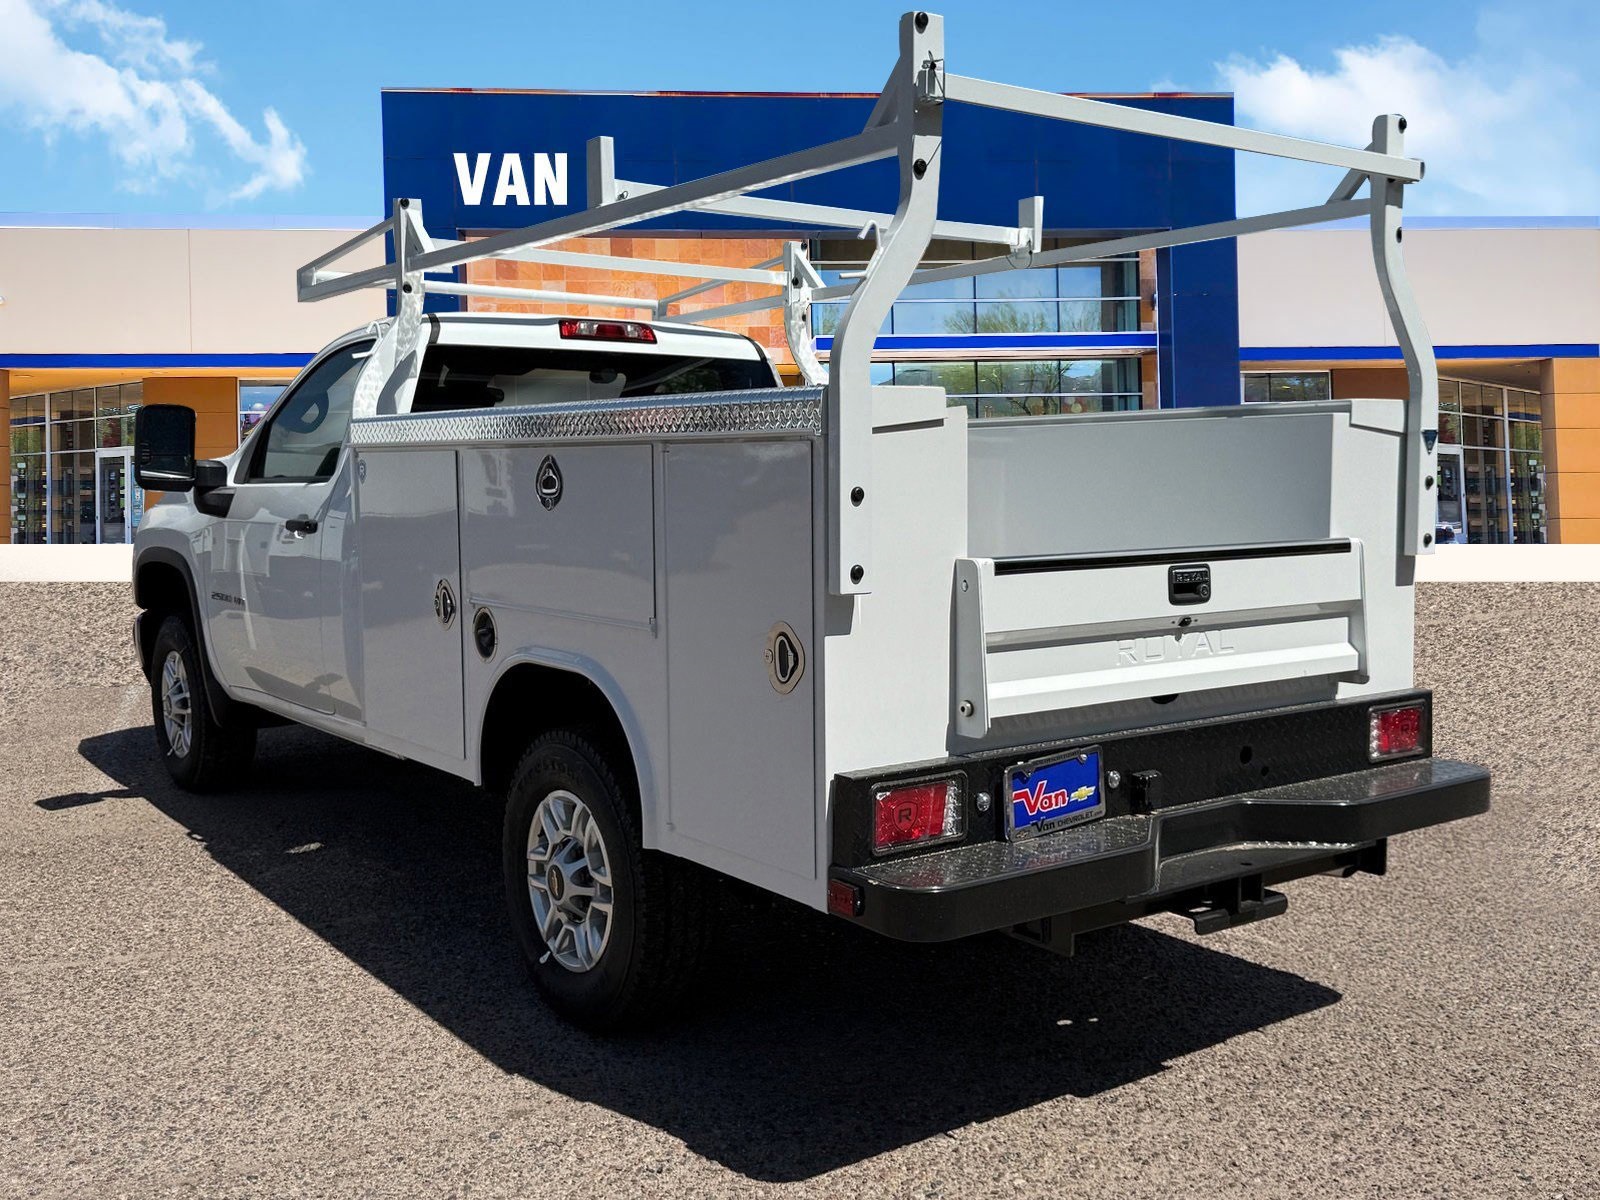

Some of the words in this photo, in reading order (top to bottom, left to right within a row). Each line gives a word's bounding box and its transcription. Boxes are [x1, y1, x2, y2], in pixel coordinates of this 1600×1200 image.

[453, 152, 568, 206] VAN
[1115, 630, 1235, 667] ROYAL
[898, 807, 912, 823] R
[1012, 779, 1069, 816] Van
[1030, 816, 1056, 833] Van
